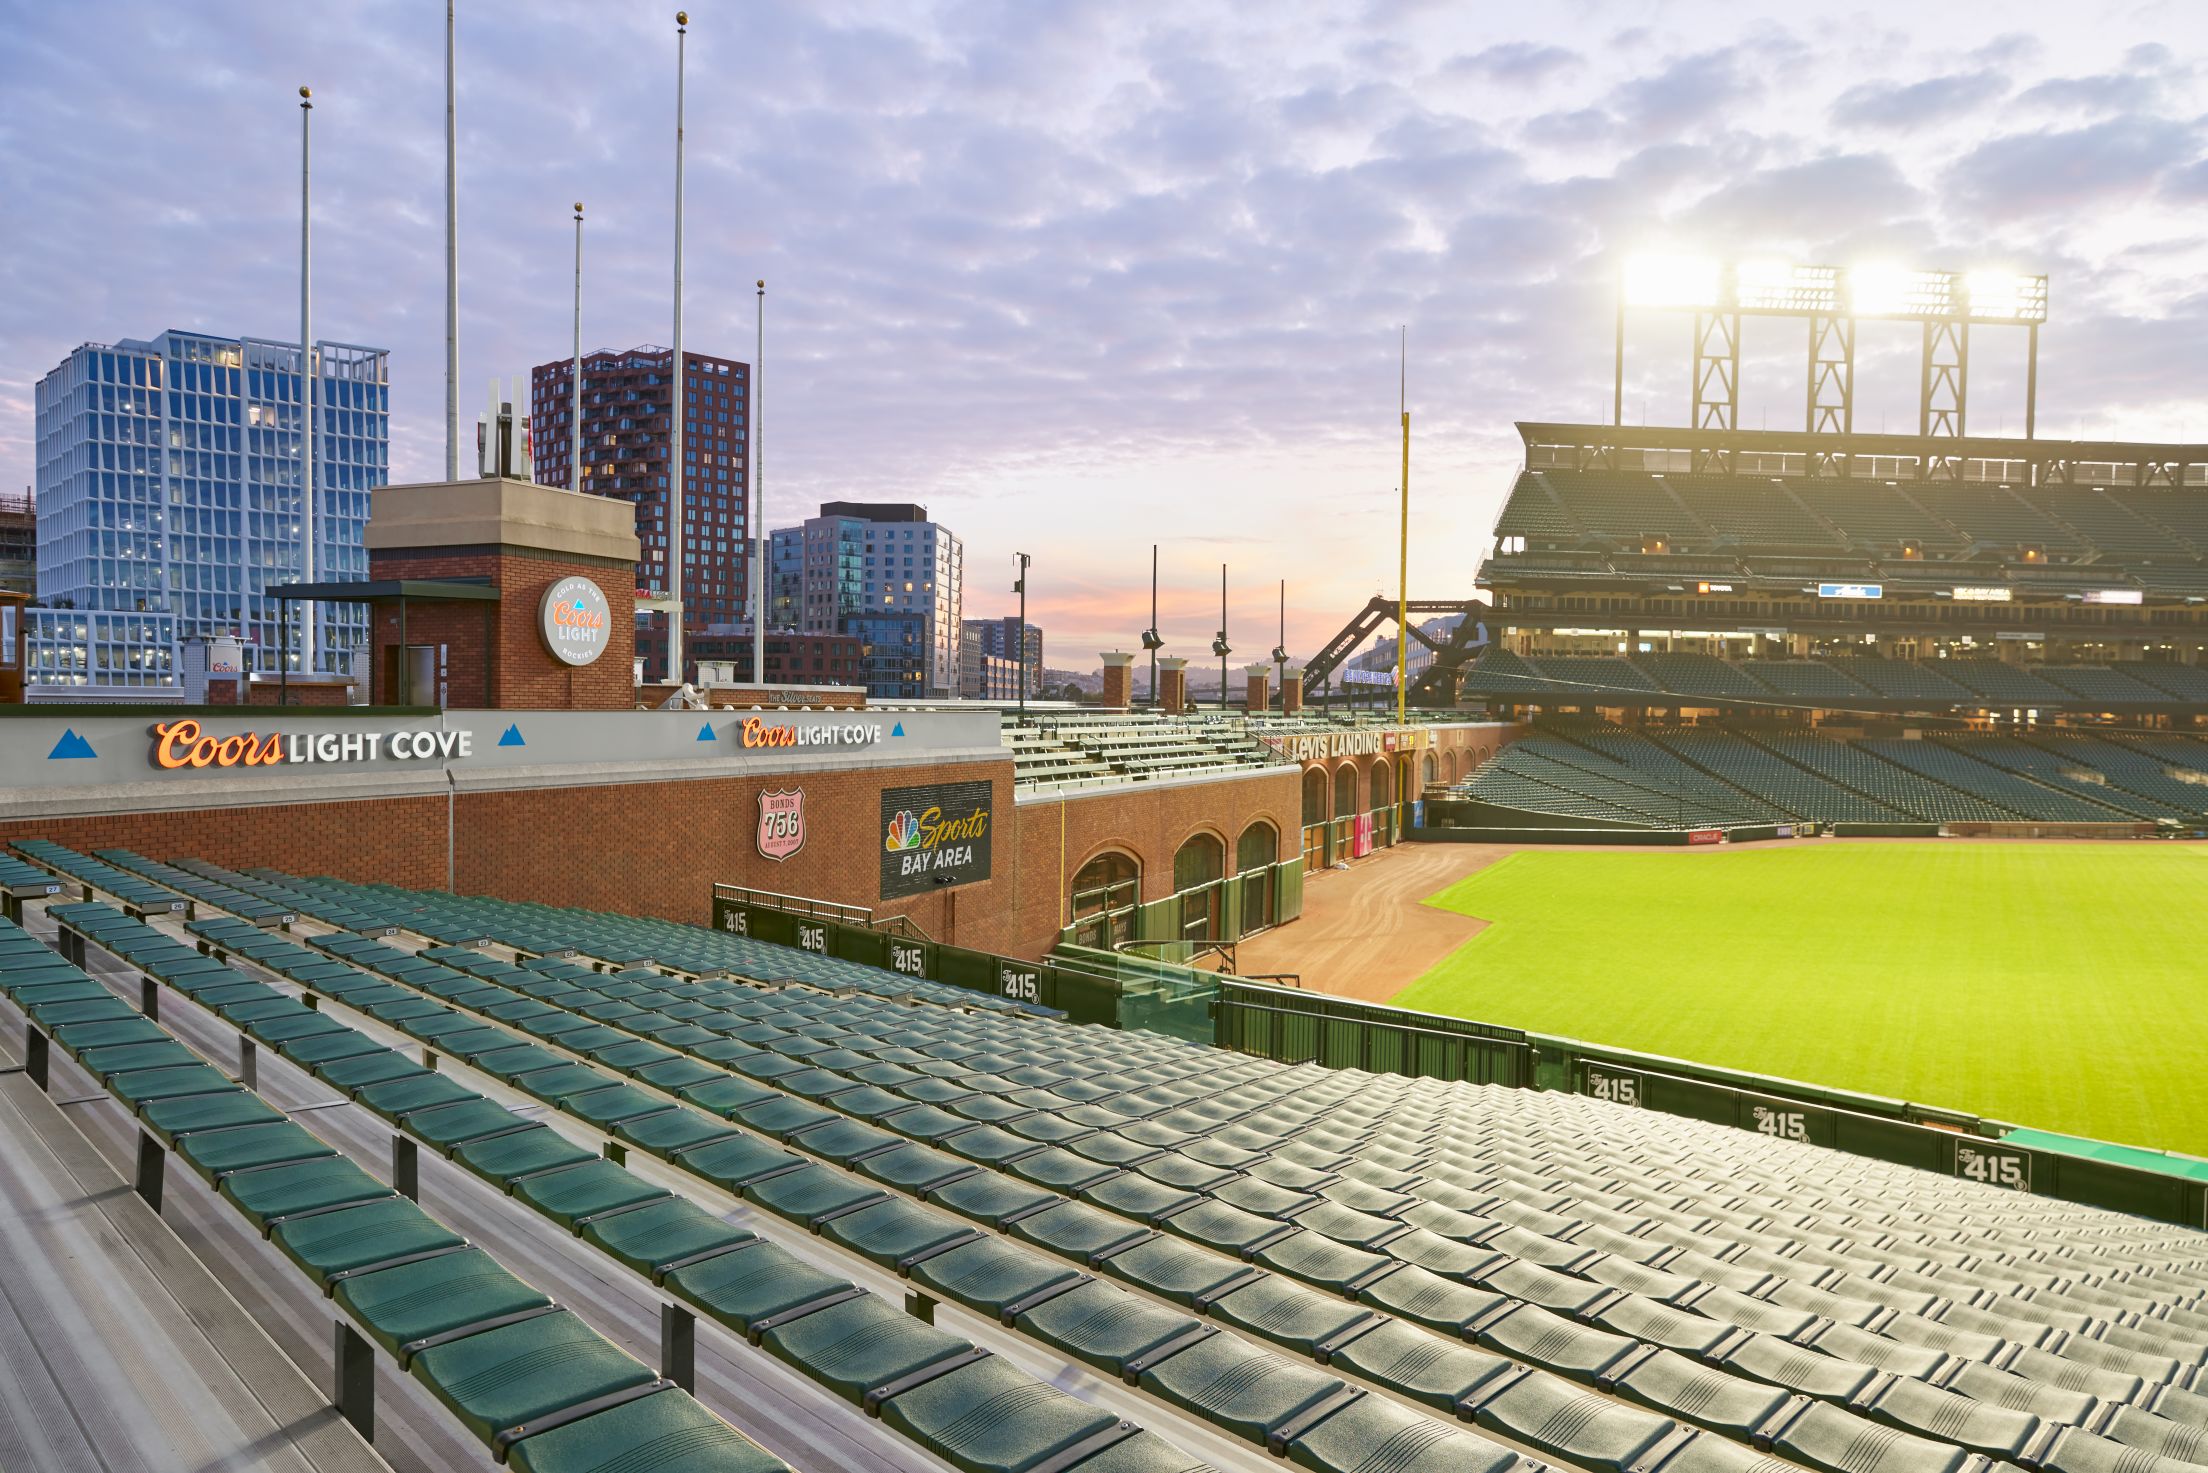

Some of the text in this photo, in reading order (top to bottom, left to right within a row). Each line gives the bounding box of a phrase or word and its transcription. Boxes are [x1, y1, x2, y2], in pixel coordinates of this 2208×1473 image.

[556, 583, 574, 598] COLD
[588, 588, 600, 602] THE
[553, 600, 604, 629] Coors
[558, 626, 598, 642] LIGHT
[562, 647, 593, 660] ROCKIES
[212, 662, 238, 673] Coors
[781, 690, 805, 703] Silver
[742, 716, 881, 748] Coors LIGHT COVE
[156, 719, 473, 769] Coors LIGHT COVE
[1331, 732, 1381, 758] LANDING
[770, 799, 795, 810] BONDS
[765, 810, 799, 839] 756
[919, 806, 989, 855] Sports
[901, 845, 973, 876] BAY AREA
[726, 912, 747, 932] 415
[801, 929, 825, 950] 415
[1078, 930, 1097, 945] BONDS
[895, 949, 922, 972] 415
[1005, 973, 1036, 998] 415
[1594, 1078, 1635, 1101] 415
[1757, 1111, 1806, 1138] 415
[1964, 1154, 2021, 1184] 415
